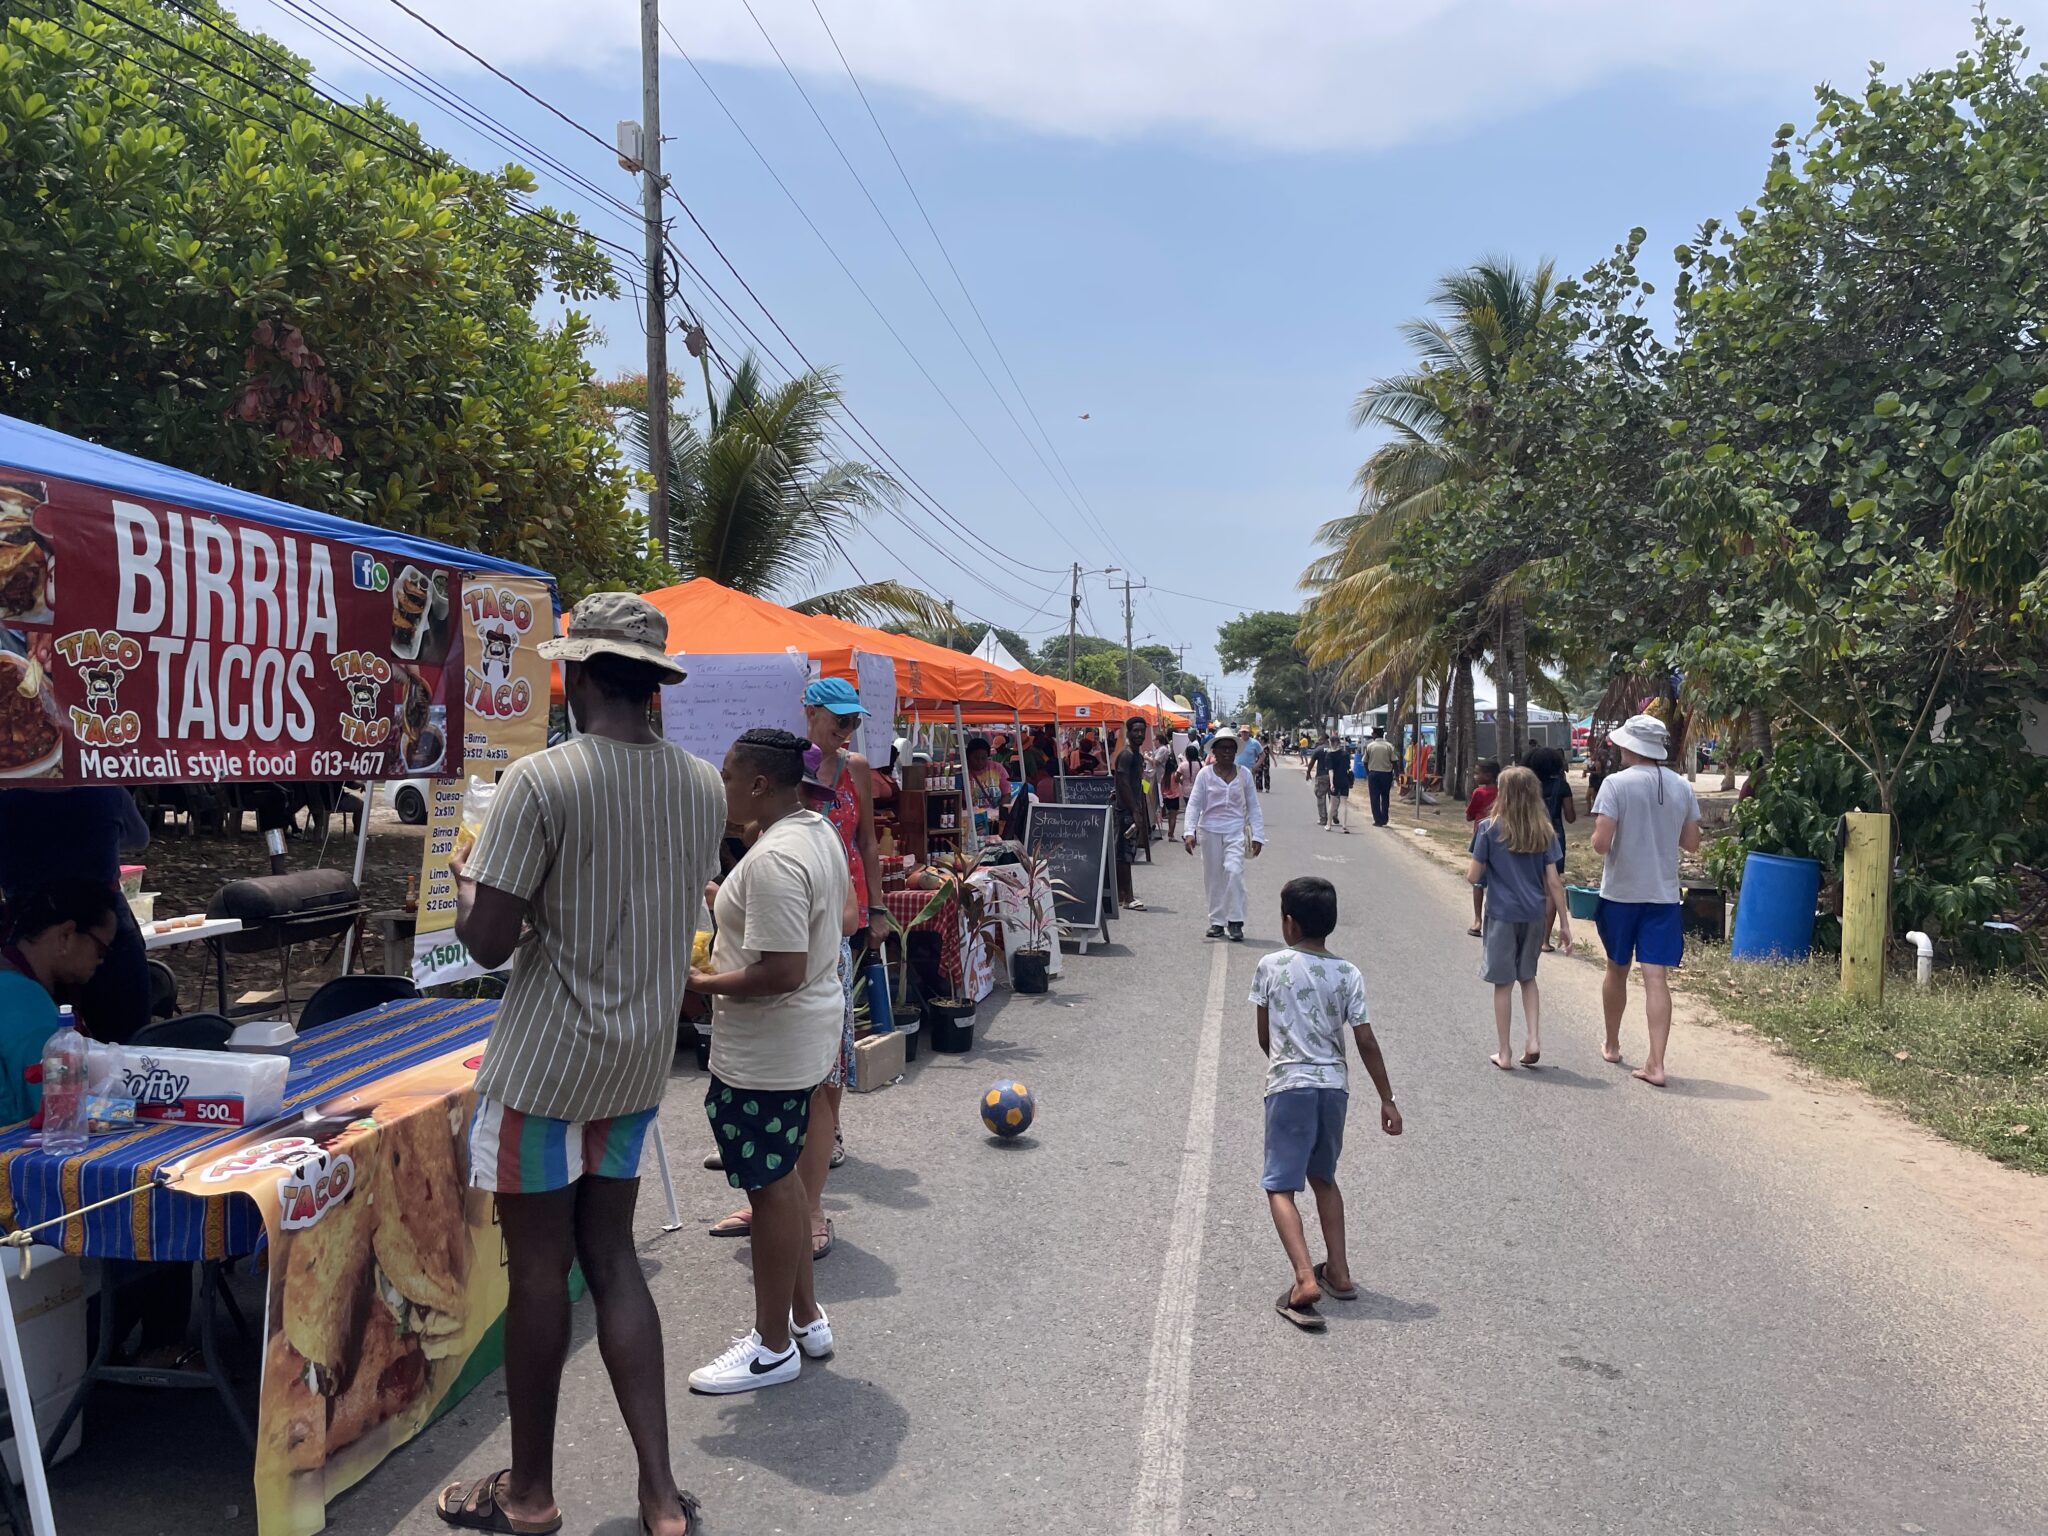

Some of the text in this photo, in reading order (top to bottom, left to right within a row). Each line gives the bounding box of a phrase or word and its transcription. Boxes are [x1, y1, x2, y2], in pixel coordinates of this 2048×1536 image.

[112, 500, 340, 654] BIRRIA
[461, 585, 535, 632] TACO
[55, 629, 142, 670] TACO
[331, 650, 391, 684] TACO
[148, 636, 316, 742] TACOS
[465, 668, 532, 717] TACO
[69, 705, 141, 747] TACO
[340, 712, 391, 747] TACO
[80, 749, 385, 783] Mexicali style food 613-4677
[434, 806, 455, 817] 2x$10
[435, 792, 464, 802] Quesa-
[431, 843, 452, 854] 2x$10
[433, 827, 453, 838] Birria
[428, 884, 450, 896] Juice
[429, 868, 449, 880] Lime
[426, 898, 458, 911] $2 Each
[197, 1103, 229, 1120] 500
[210, 1139, 306, 1178] TACO
[283, 1161, 350, 1222] TACO
